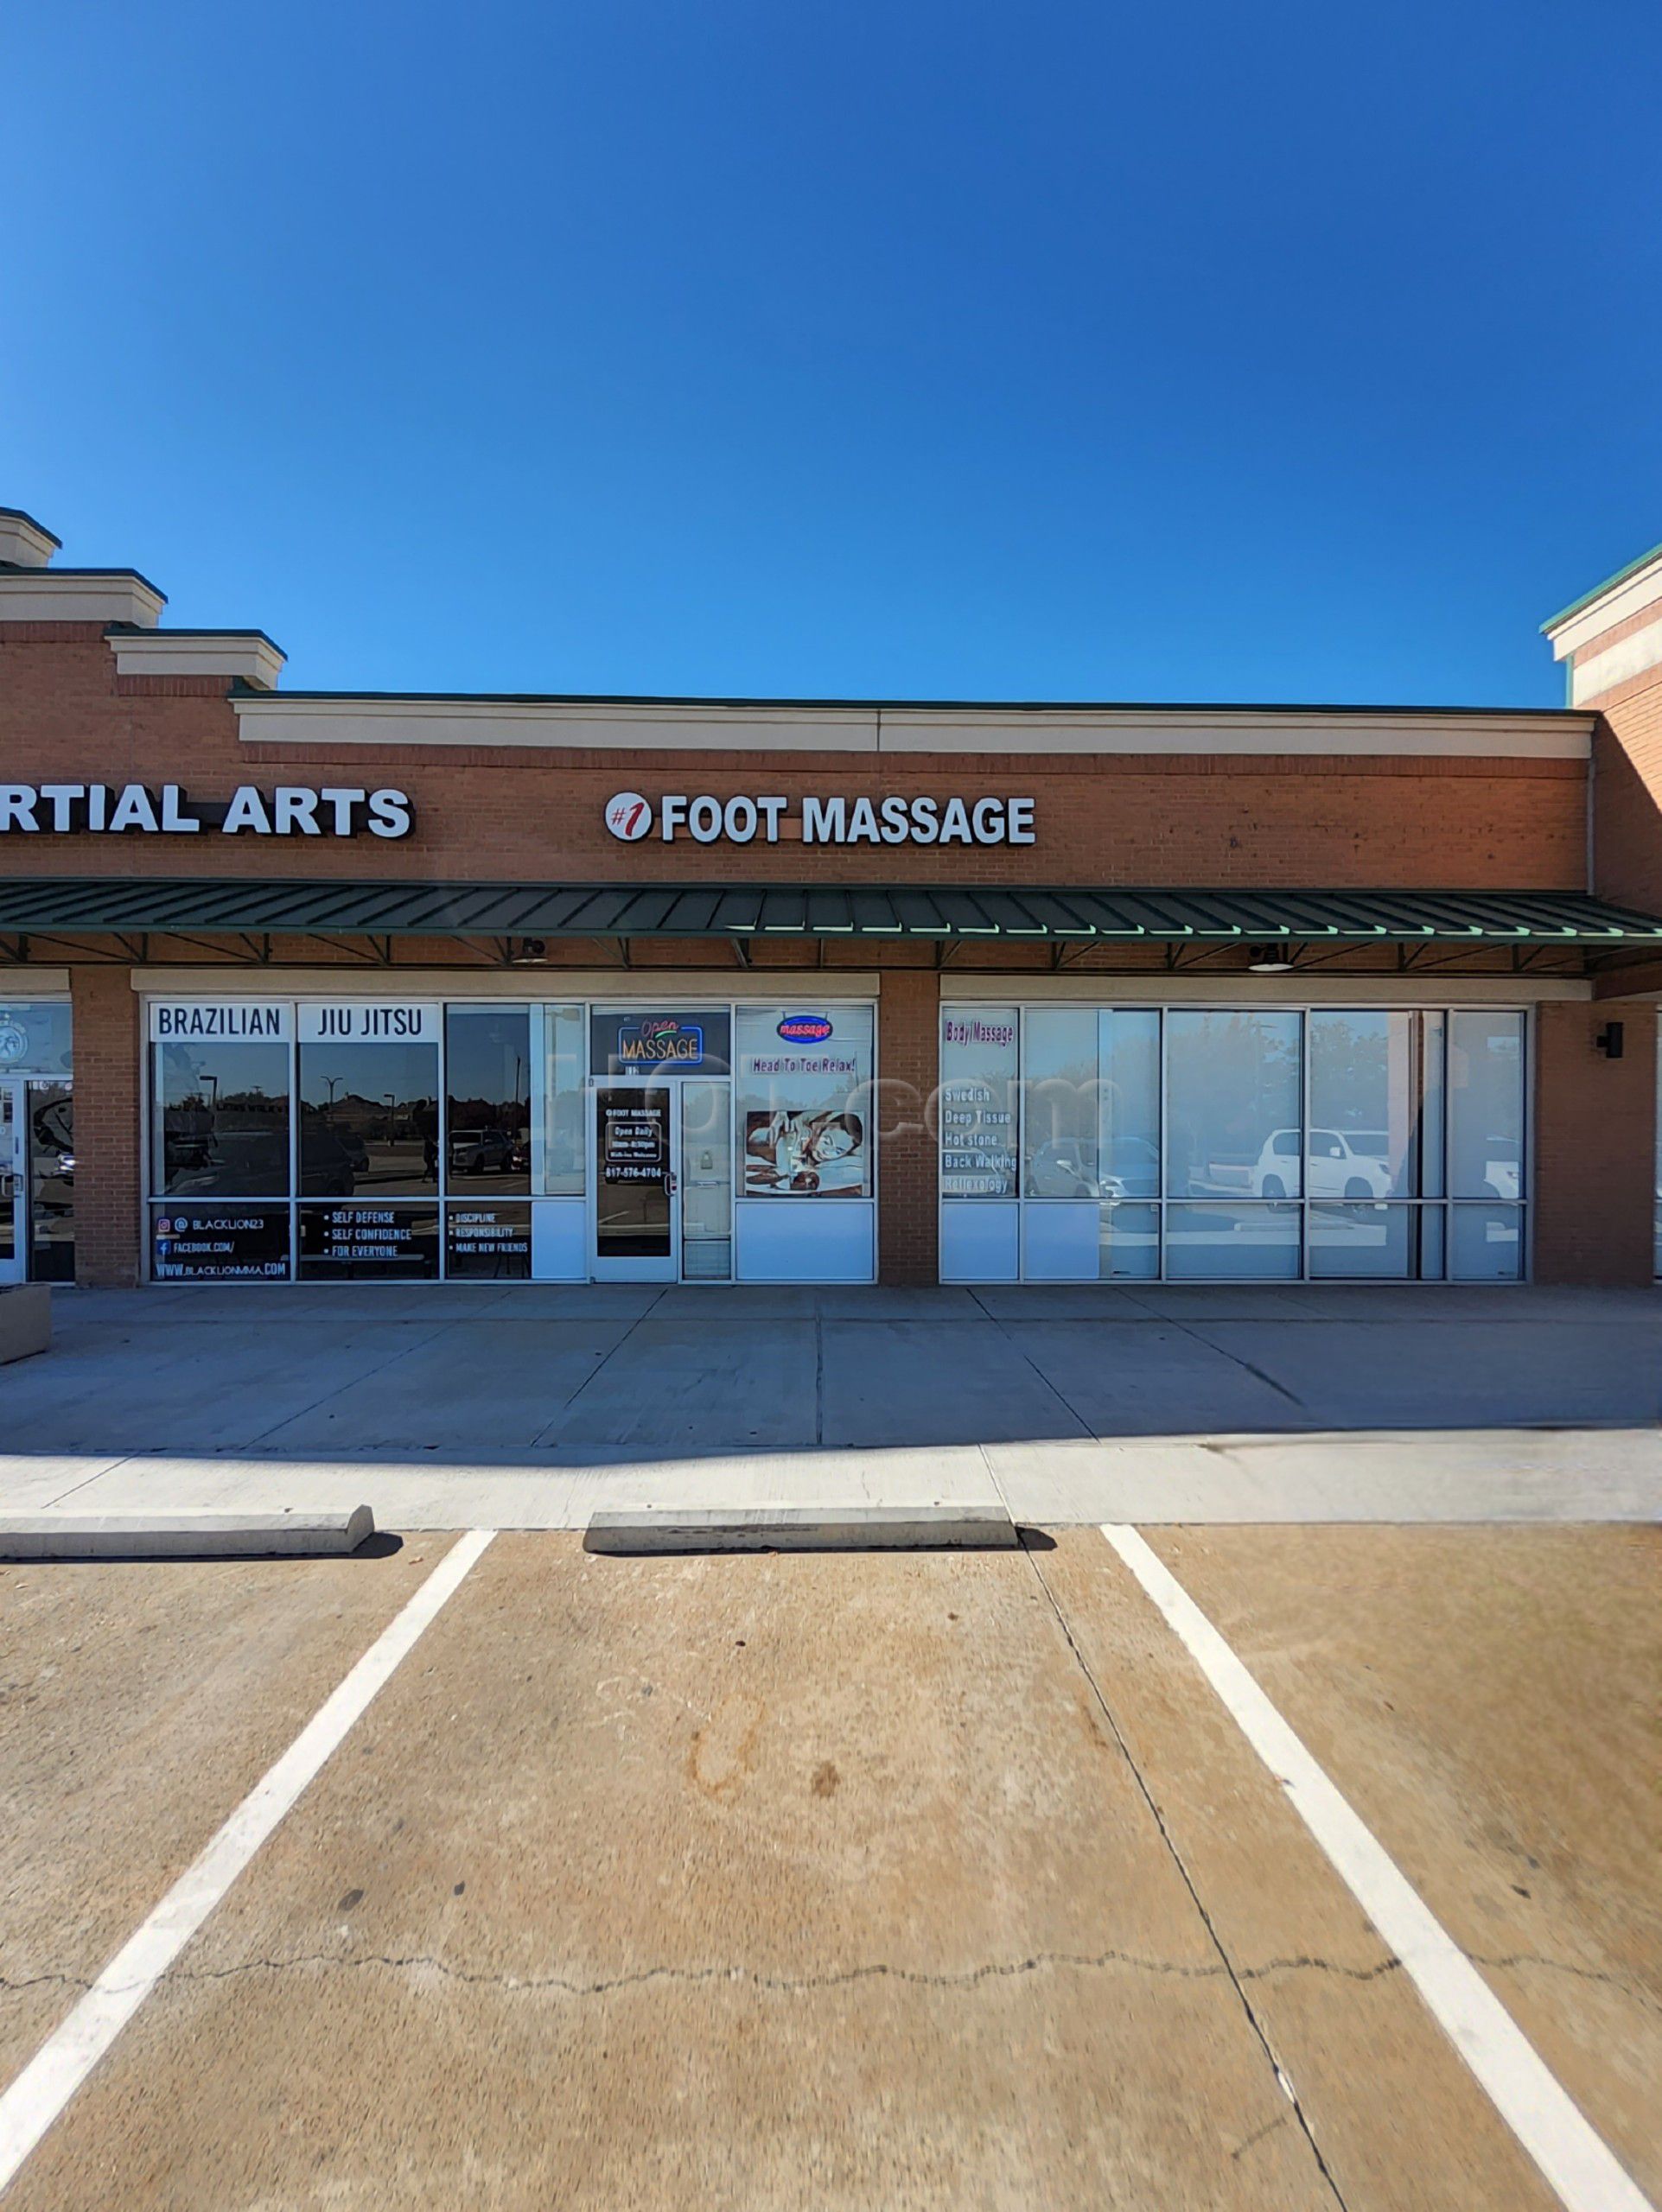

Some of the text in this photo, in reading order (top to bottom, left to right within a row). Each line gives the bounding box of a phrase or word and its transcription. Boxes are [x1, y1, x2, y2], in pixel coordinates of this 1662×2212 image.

[222, 785, 411, 840] ARTS
[610, 796, 1036, 844] #1 FOOT MASSAGE
[159, 1008, 422, 1036] BRAZILIAN JIU JITSU
[641, 1020, 679, 1038] Open
[780, 1024, 831, 1038] massage
[946, 1021, 1013, 1047] Body Massage
[621, 1039, 698, 1059] MASSAGE
[753, 1057, 856, 1072] Head To Toe Relax!
[945, 1087, 990, 1102] Swedish
[945, 1109, 1011, 1127] Deep Tissue
[945, 1131, 965, 1147] Hot
[945, 1154, 1017, 1172] Back Walking
[332, 1211, 395, 1224] SELF DEFENSE
[332, 1229, 412, 1240] SELF CONFIDENCE
[332, 1245, 398, 1257] FOR EVERYONE
